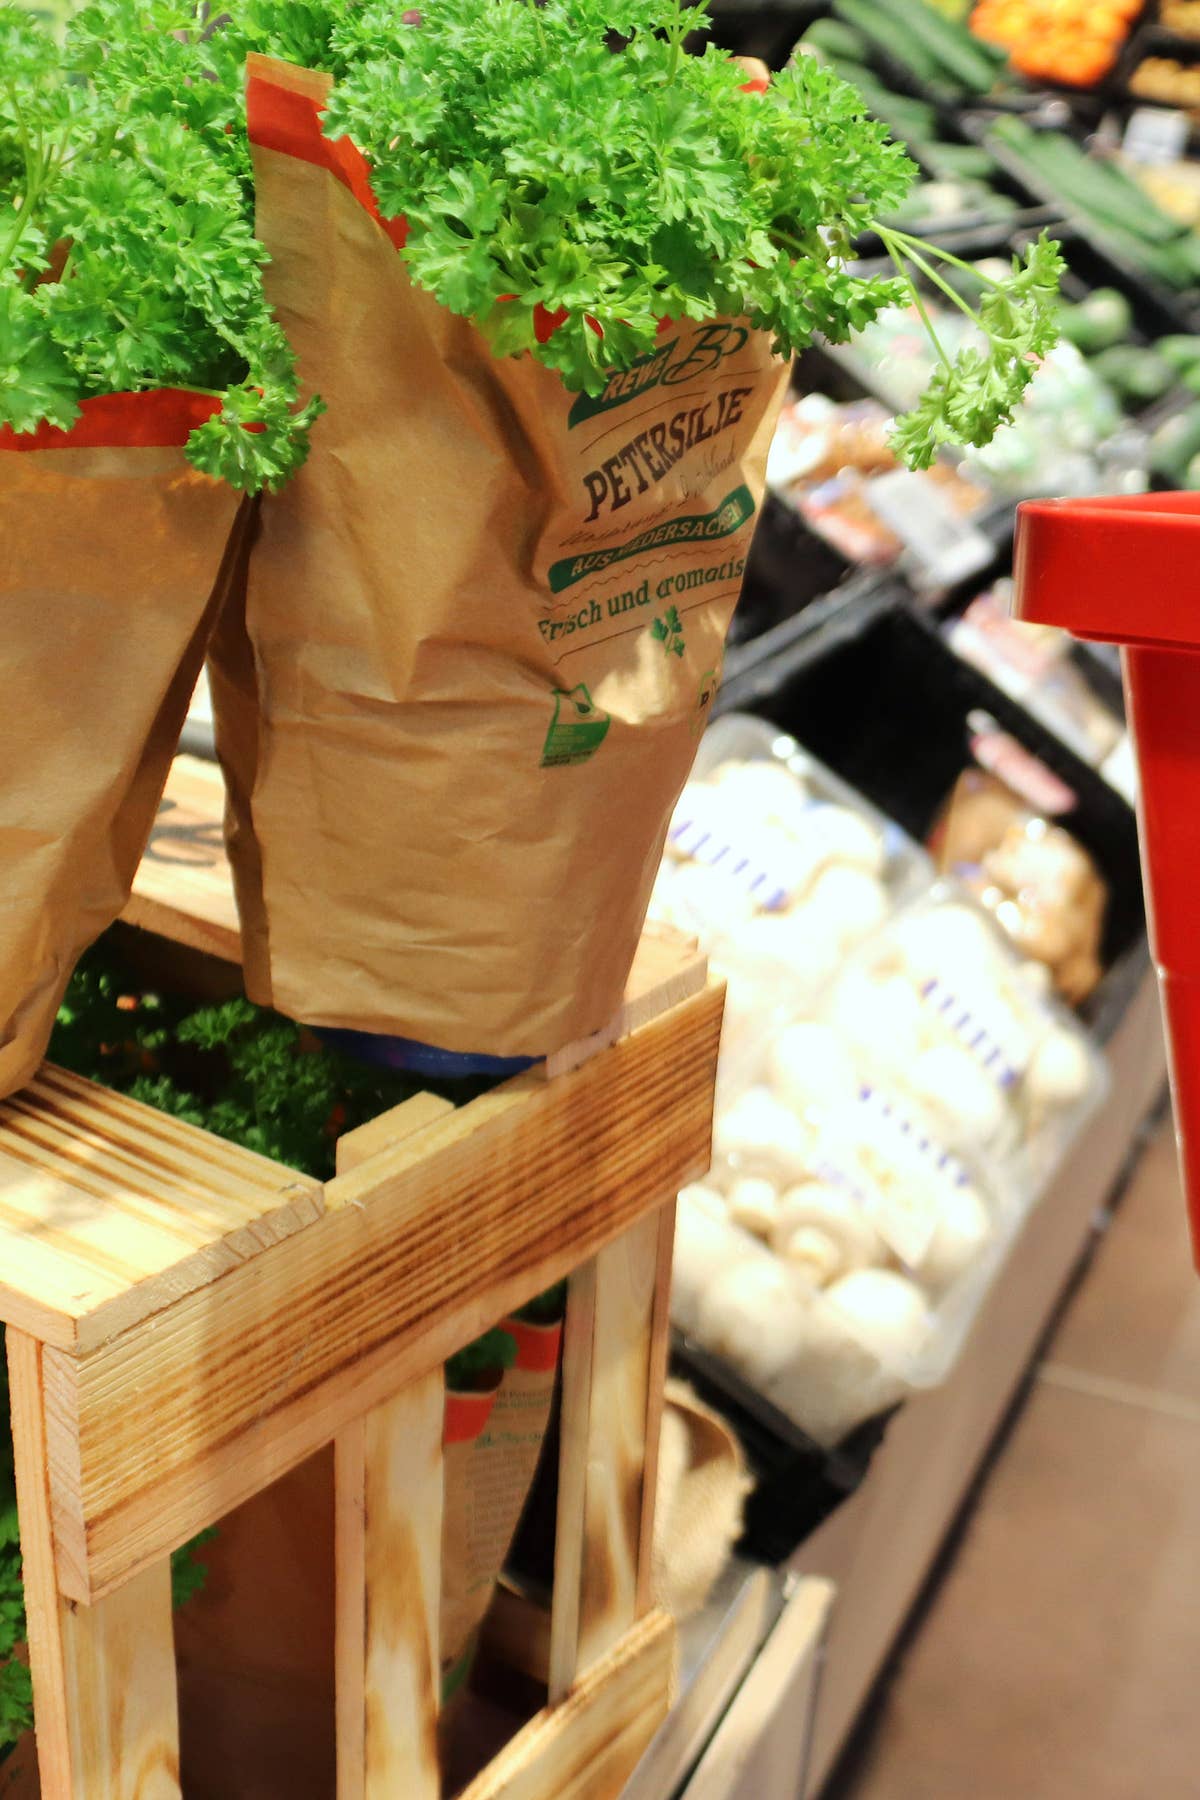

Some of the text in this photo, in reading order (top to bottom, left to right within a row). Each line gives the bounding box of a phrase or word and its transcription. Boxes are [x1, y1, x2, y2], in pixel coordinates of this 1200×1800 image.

[601, 350, 668, 402] REWE
[582, 387, 753, 524] PETERSILIE
[571, 551, 614, 577] AUS
[614, 499, 744, 557] EDERSACHEN
[607, 580, 649, 617] und
